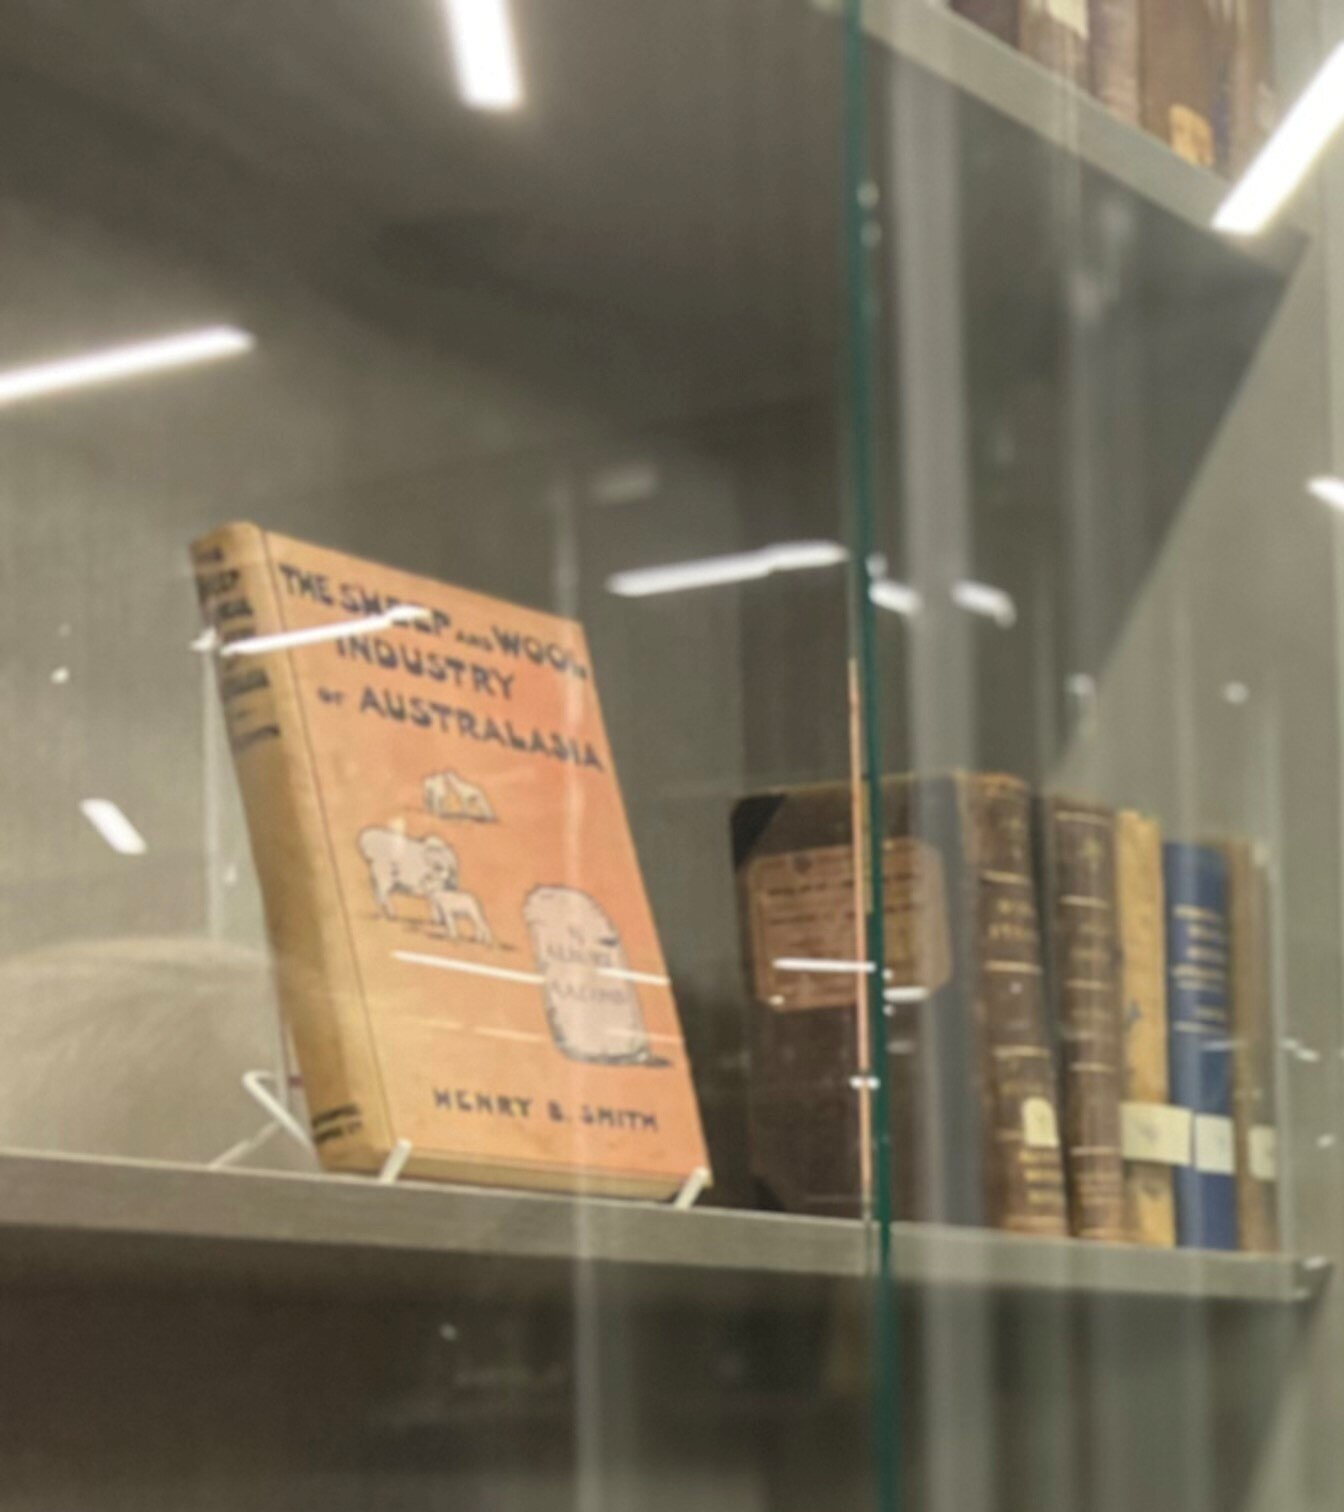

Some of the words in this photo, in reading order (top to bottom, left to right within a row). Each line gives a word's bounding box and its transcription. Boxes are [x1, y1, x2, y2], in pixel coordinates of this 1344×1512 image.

[279, 563, 334, 606] THE
[336, 635, 515, 701] INDUSTRY
[359, 685, 605, 773] AUSTRALASIA
[433, 1088, 531, 1119] HENRY
[581, 1104, 660, 1132] SMITH
